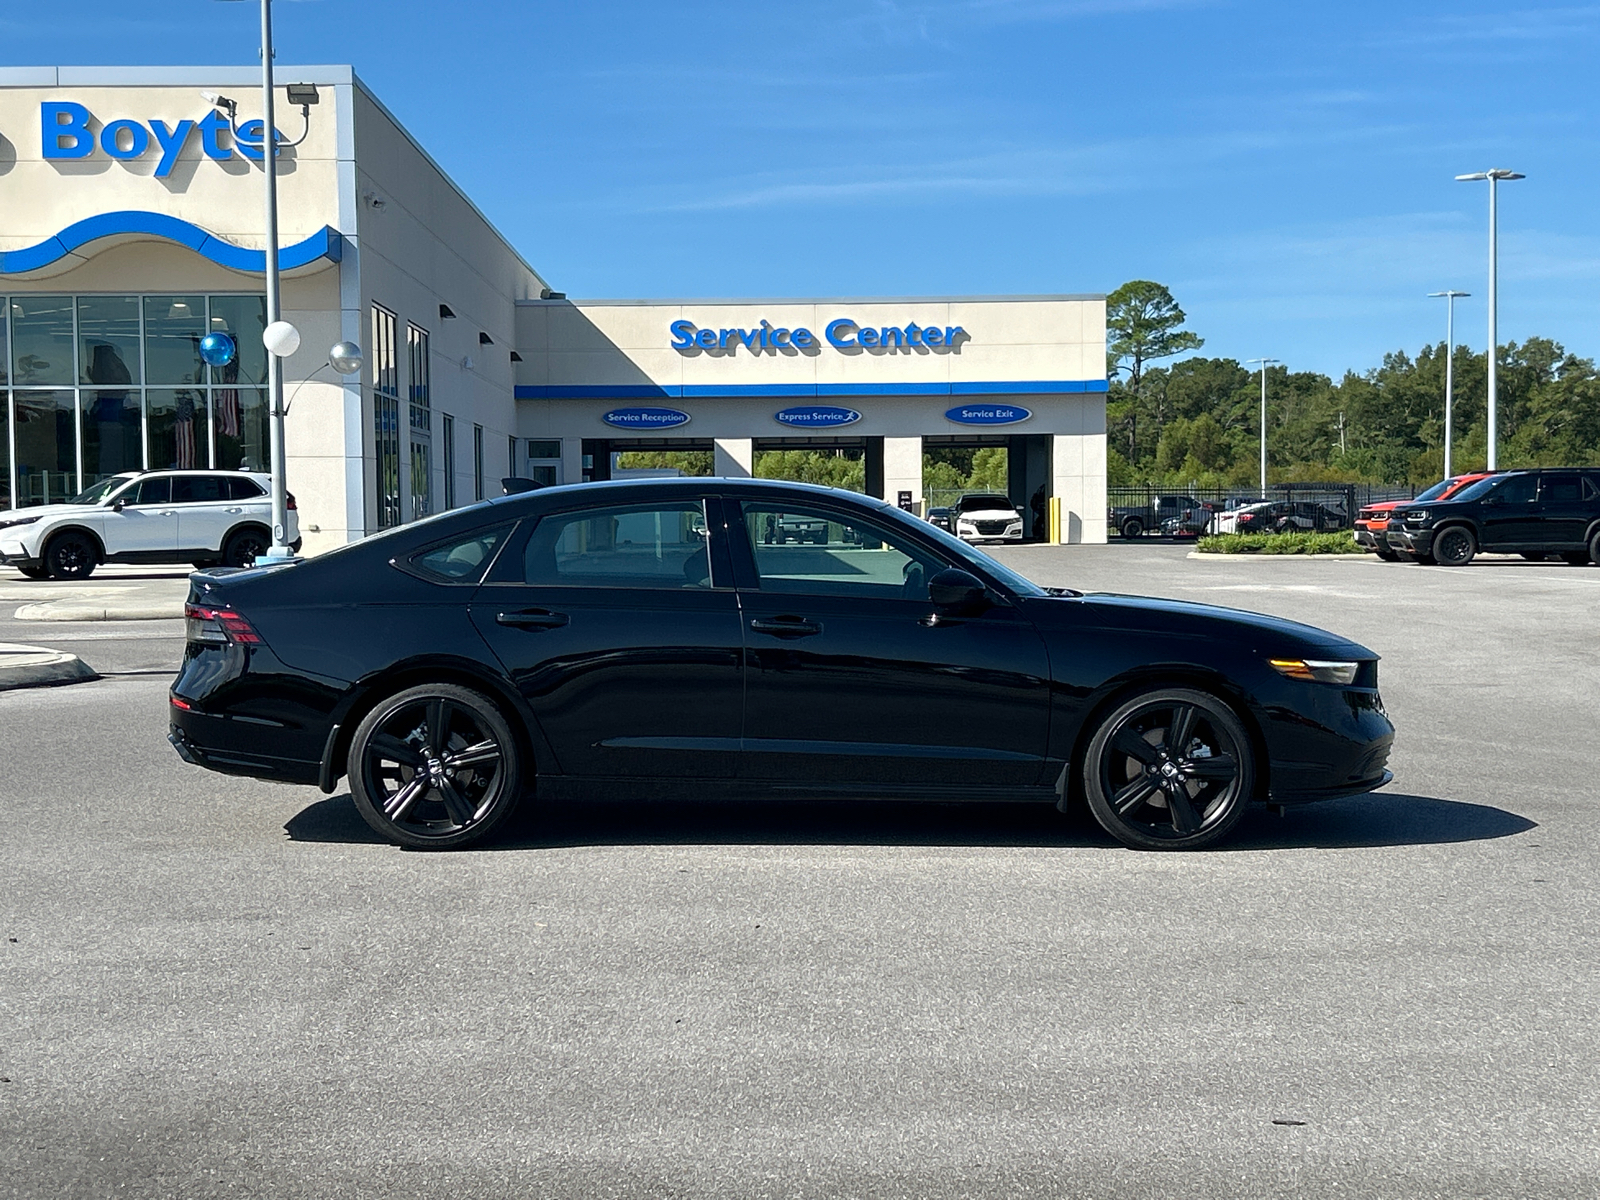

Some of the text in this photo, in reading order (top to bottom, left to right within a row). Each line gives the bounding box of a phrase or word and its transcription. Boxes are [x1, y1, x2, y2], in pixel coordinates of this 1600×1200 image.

[41, 101, 280, 177] Boyte
[670, 318, 963, 349] Service Center
[608, 413, 685, 423] Service Reception
[779, 412, 844, 422] Express Service
[962, 409, 1014, 418] Service Exit
